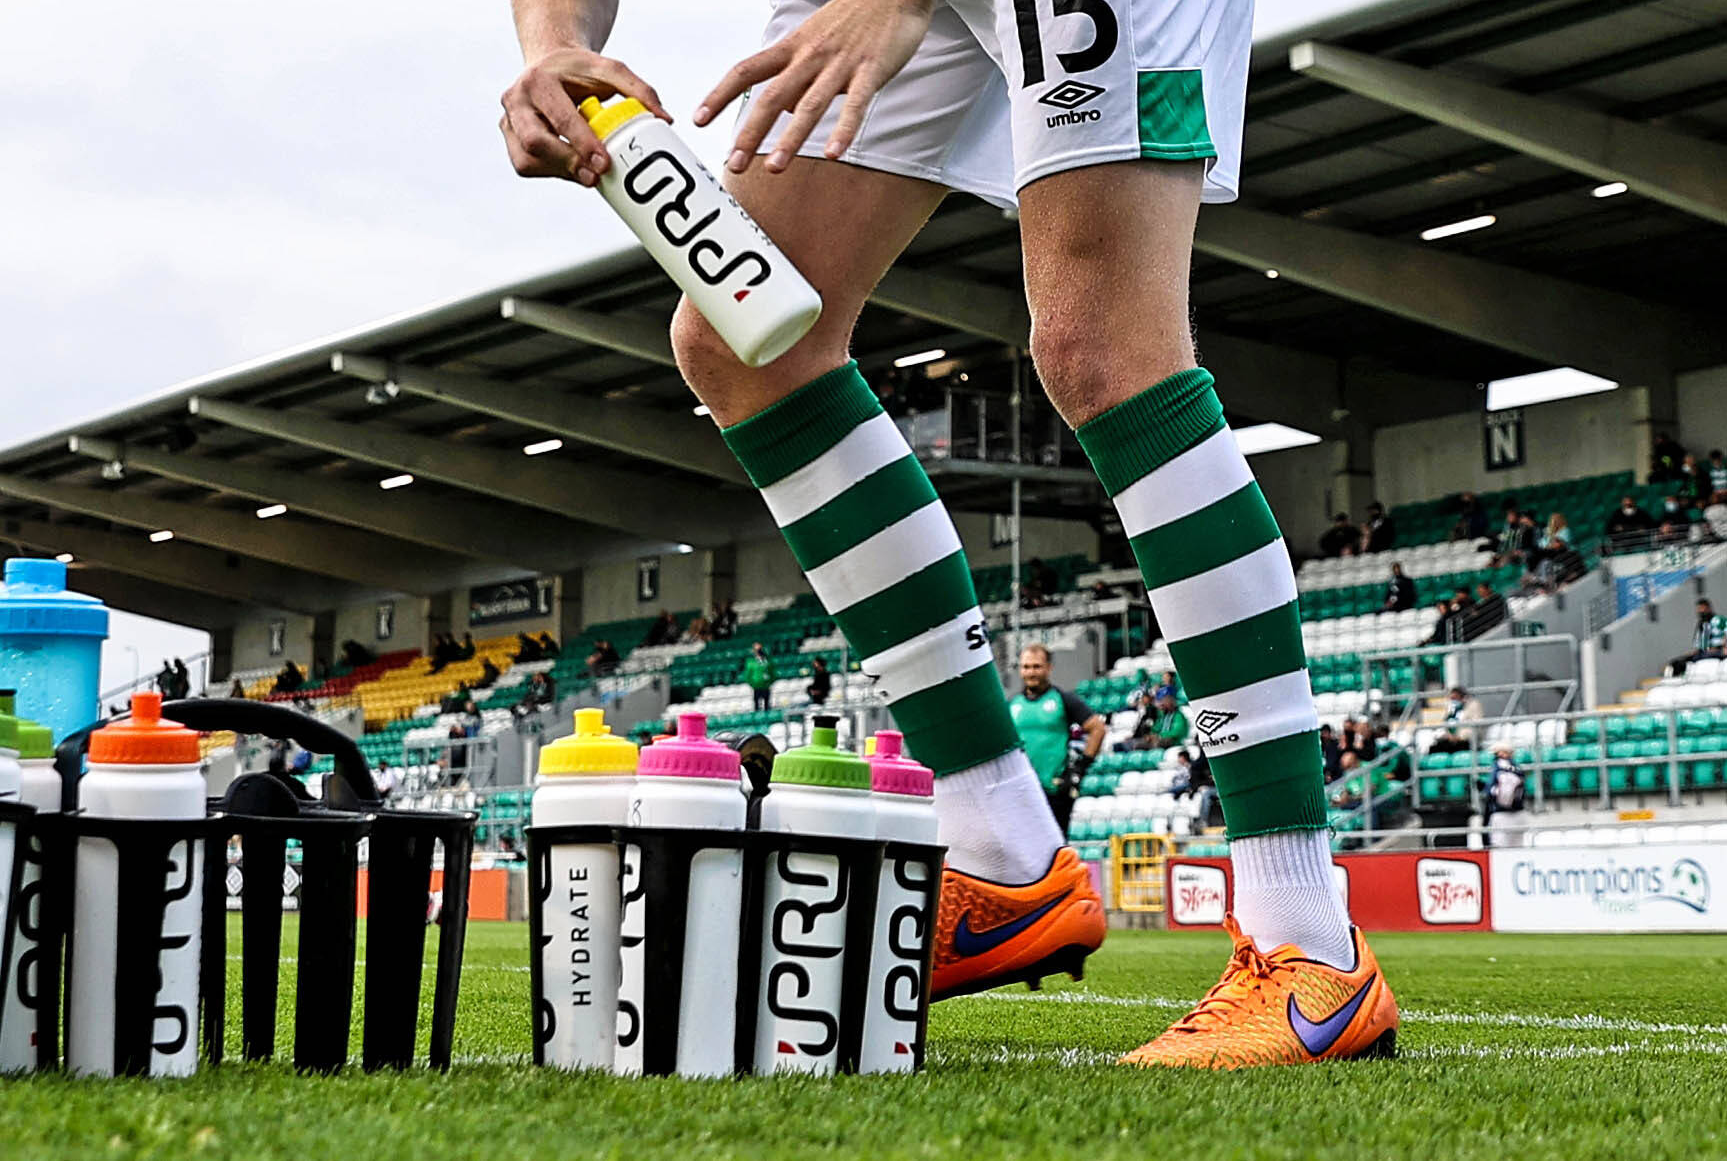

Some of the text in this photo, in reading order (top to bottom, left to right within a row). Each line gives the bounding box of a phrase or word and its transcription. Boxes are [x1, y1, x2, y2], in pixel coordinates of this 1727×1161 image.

[1046, 108, 1102, 128] umbro
[1201, 734, 1240, 748] mbro
[1512, 859, 1663, 904] Champions
[569, 867, 592, 1006] HYDRATE
